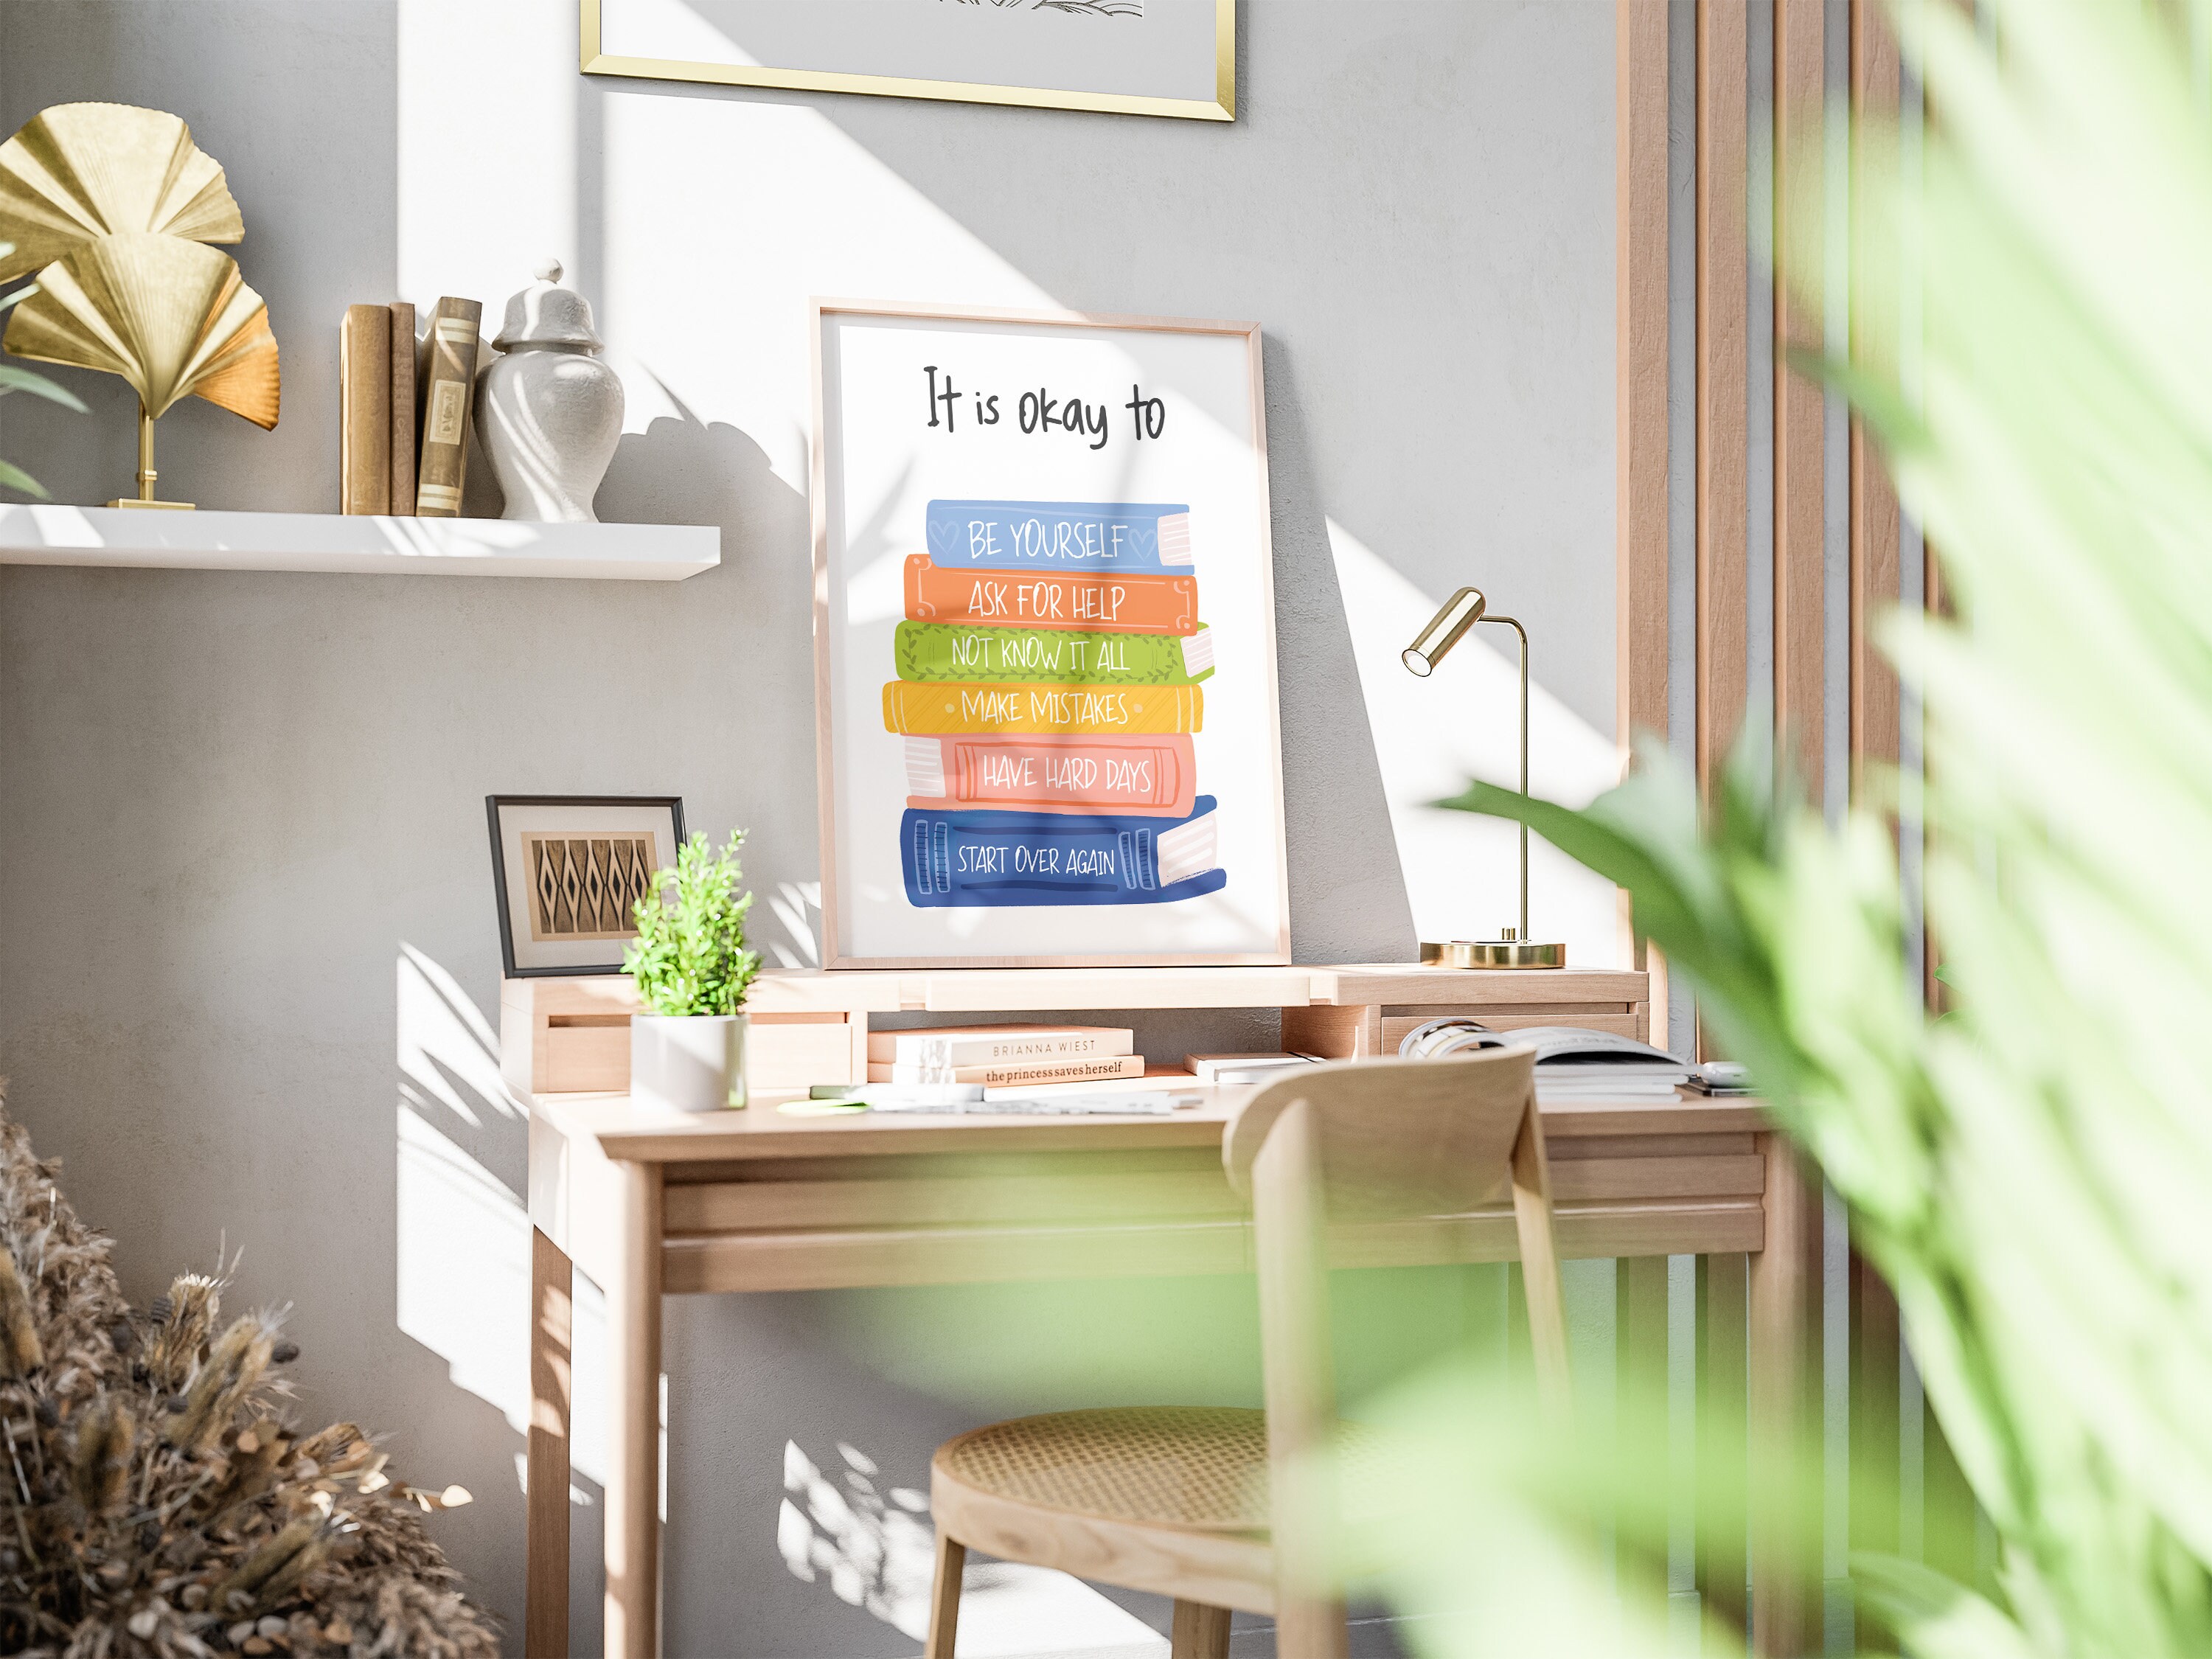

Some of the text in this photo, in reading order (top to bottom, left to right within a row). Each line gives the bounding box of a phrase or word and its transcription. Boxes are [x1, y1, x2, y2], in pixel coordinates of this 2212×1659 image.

[924, 366, 962, 433] It
[976, 392, 1000, 425] is
[1125, 384, 1165, 440] to
[968, 519, 1128, 559] BE YOURSELF
[969, 581, 1126, 621] ASK FOR HELP
[952, 635, 1130, 672] NOT KNOW IT ALL
[961, 691, 1128, 725] MAKE MISTAKES
[984, 755, 1151, 793] HAVE HARD DAYS
[958, 846, 1114, 876] START OVER AGAIN
[993, 1040, 1096, 1057] BRIANNA WIEST
[987, 1062, 1122, 1083] the princess saves herself
